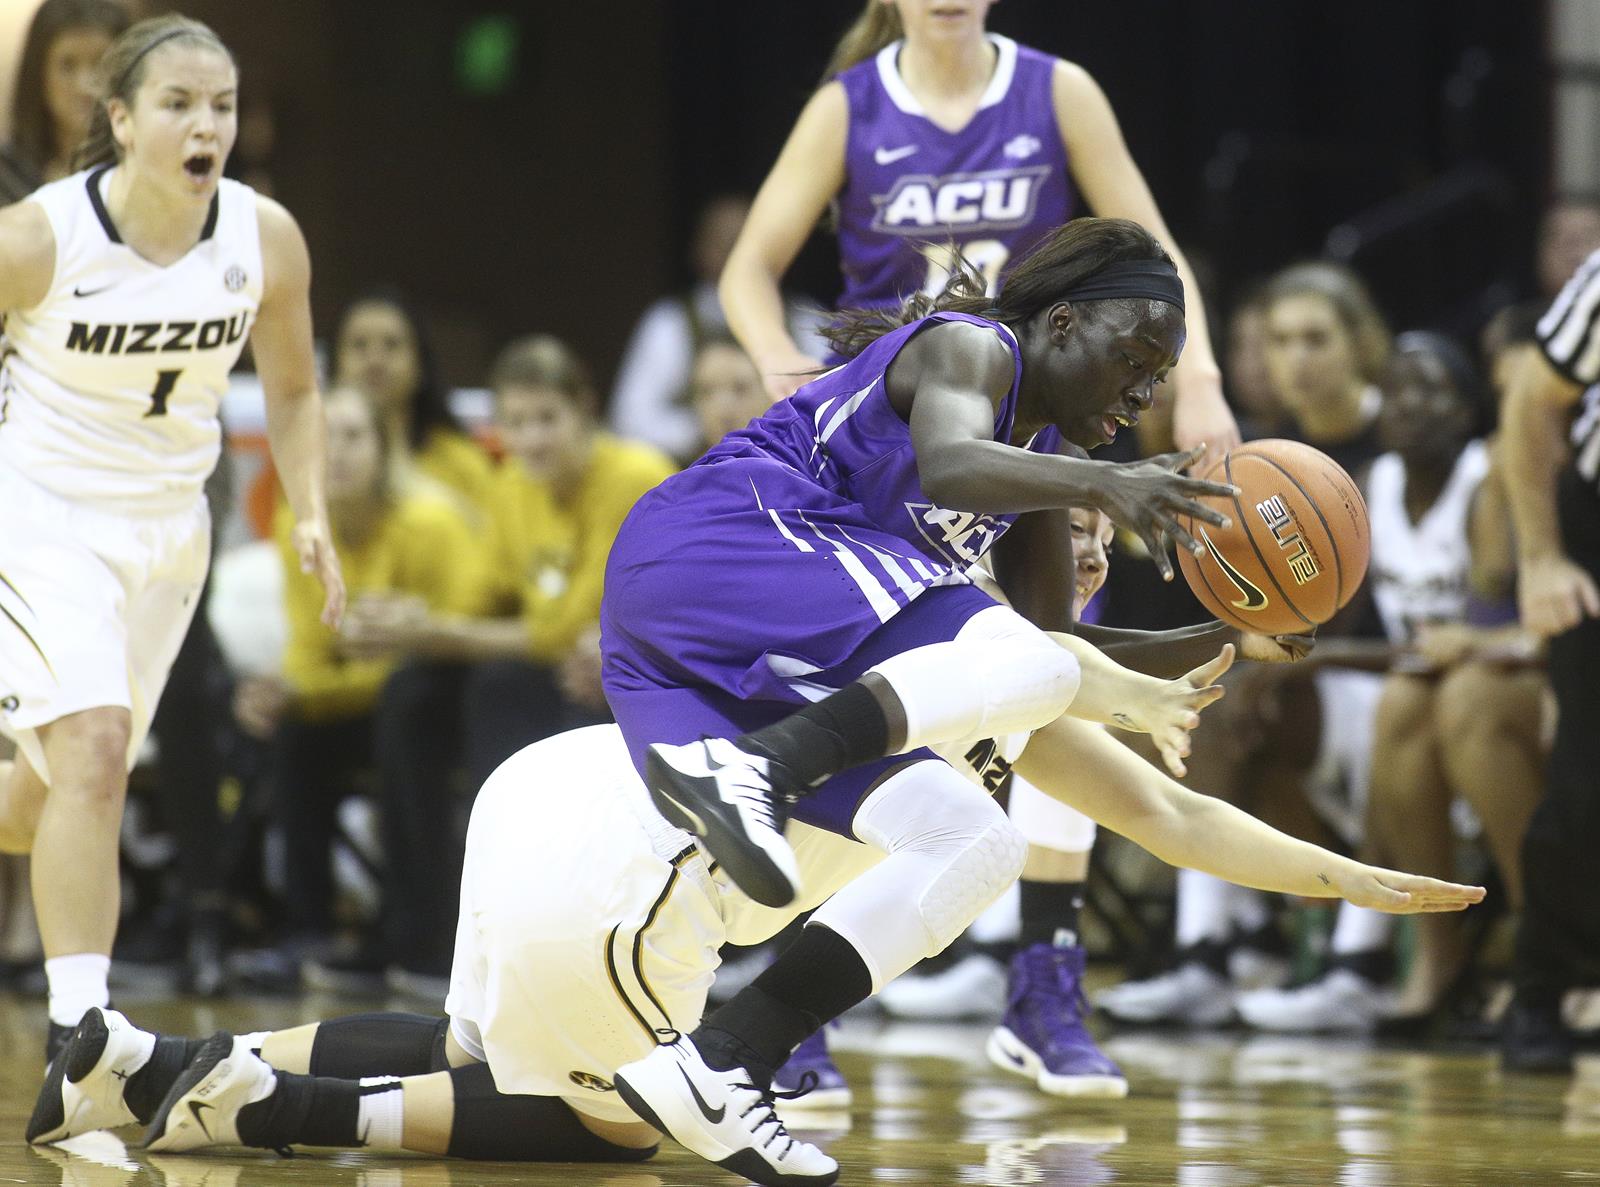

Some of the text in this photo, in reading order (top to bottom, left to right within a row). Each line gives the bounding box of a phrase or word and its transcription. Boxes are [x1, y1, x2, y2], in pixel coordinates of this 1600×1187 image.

[884, 177, 1033, 226] ACU
[65, 309, 249, 354] MIZZOU
[143, 368, 185, 418] 1
[1255, 494, 1320, 586] ELITE
